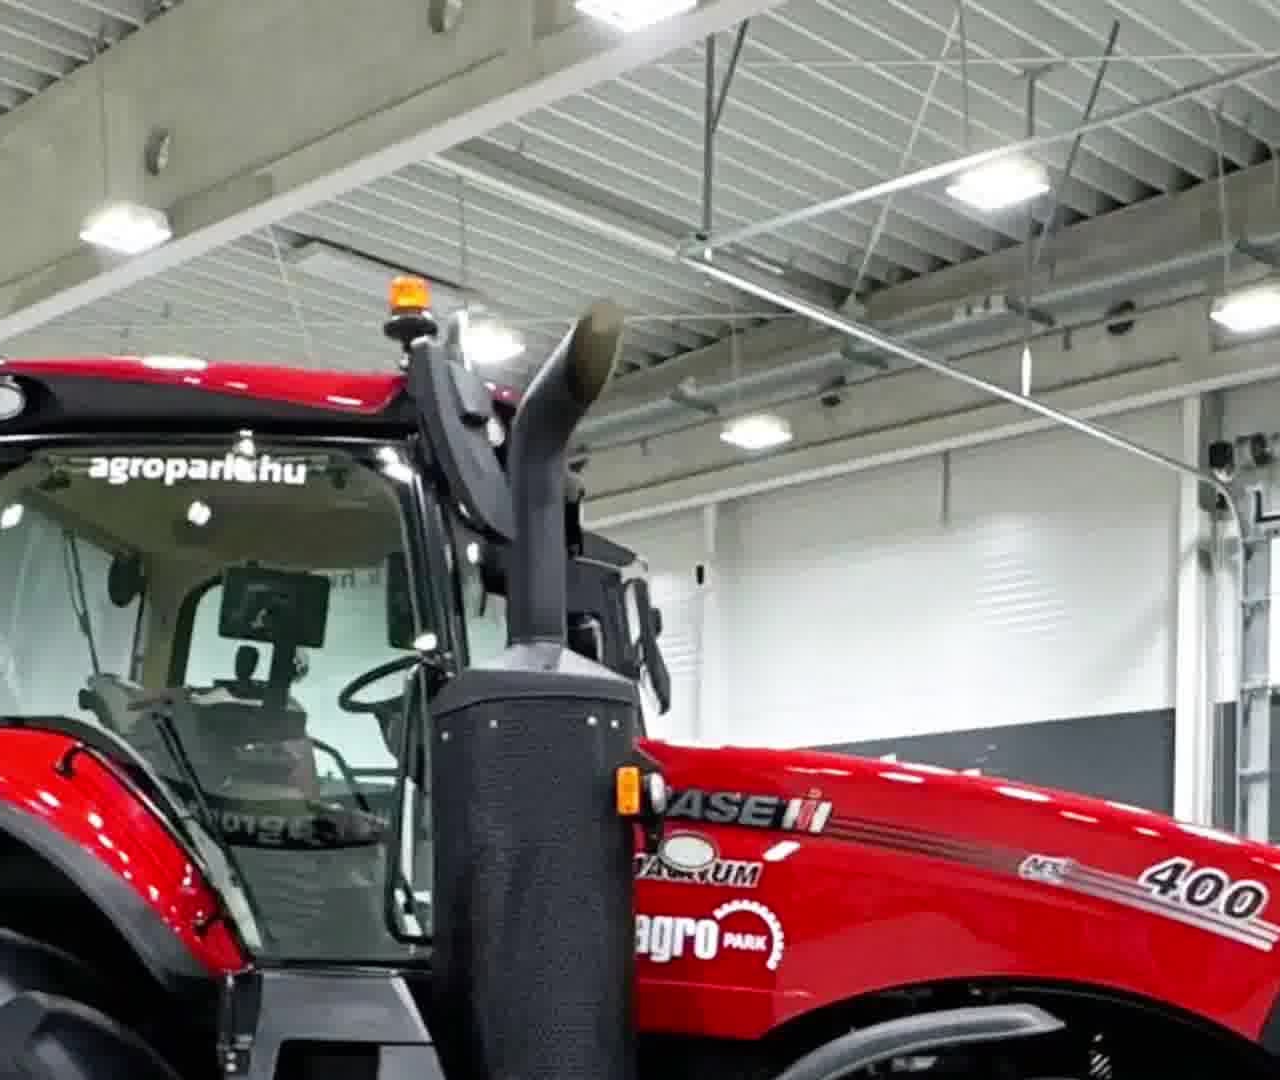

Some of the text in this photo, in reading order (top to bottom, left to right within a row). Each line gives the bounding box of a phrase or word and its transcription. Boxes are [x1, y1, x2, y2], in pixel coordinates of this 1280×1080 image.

[664, 788, 782, 827] ASE
[1141, 859, 1266, 920] 400
[723, 932, 767, 951] PARK
